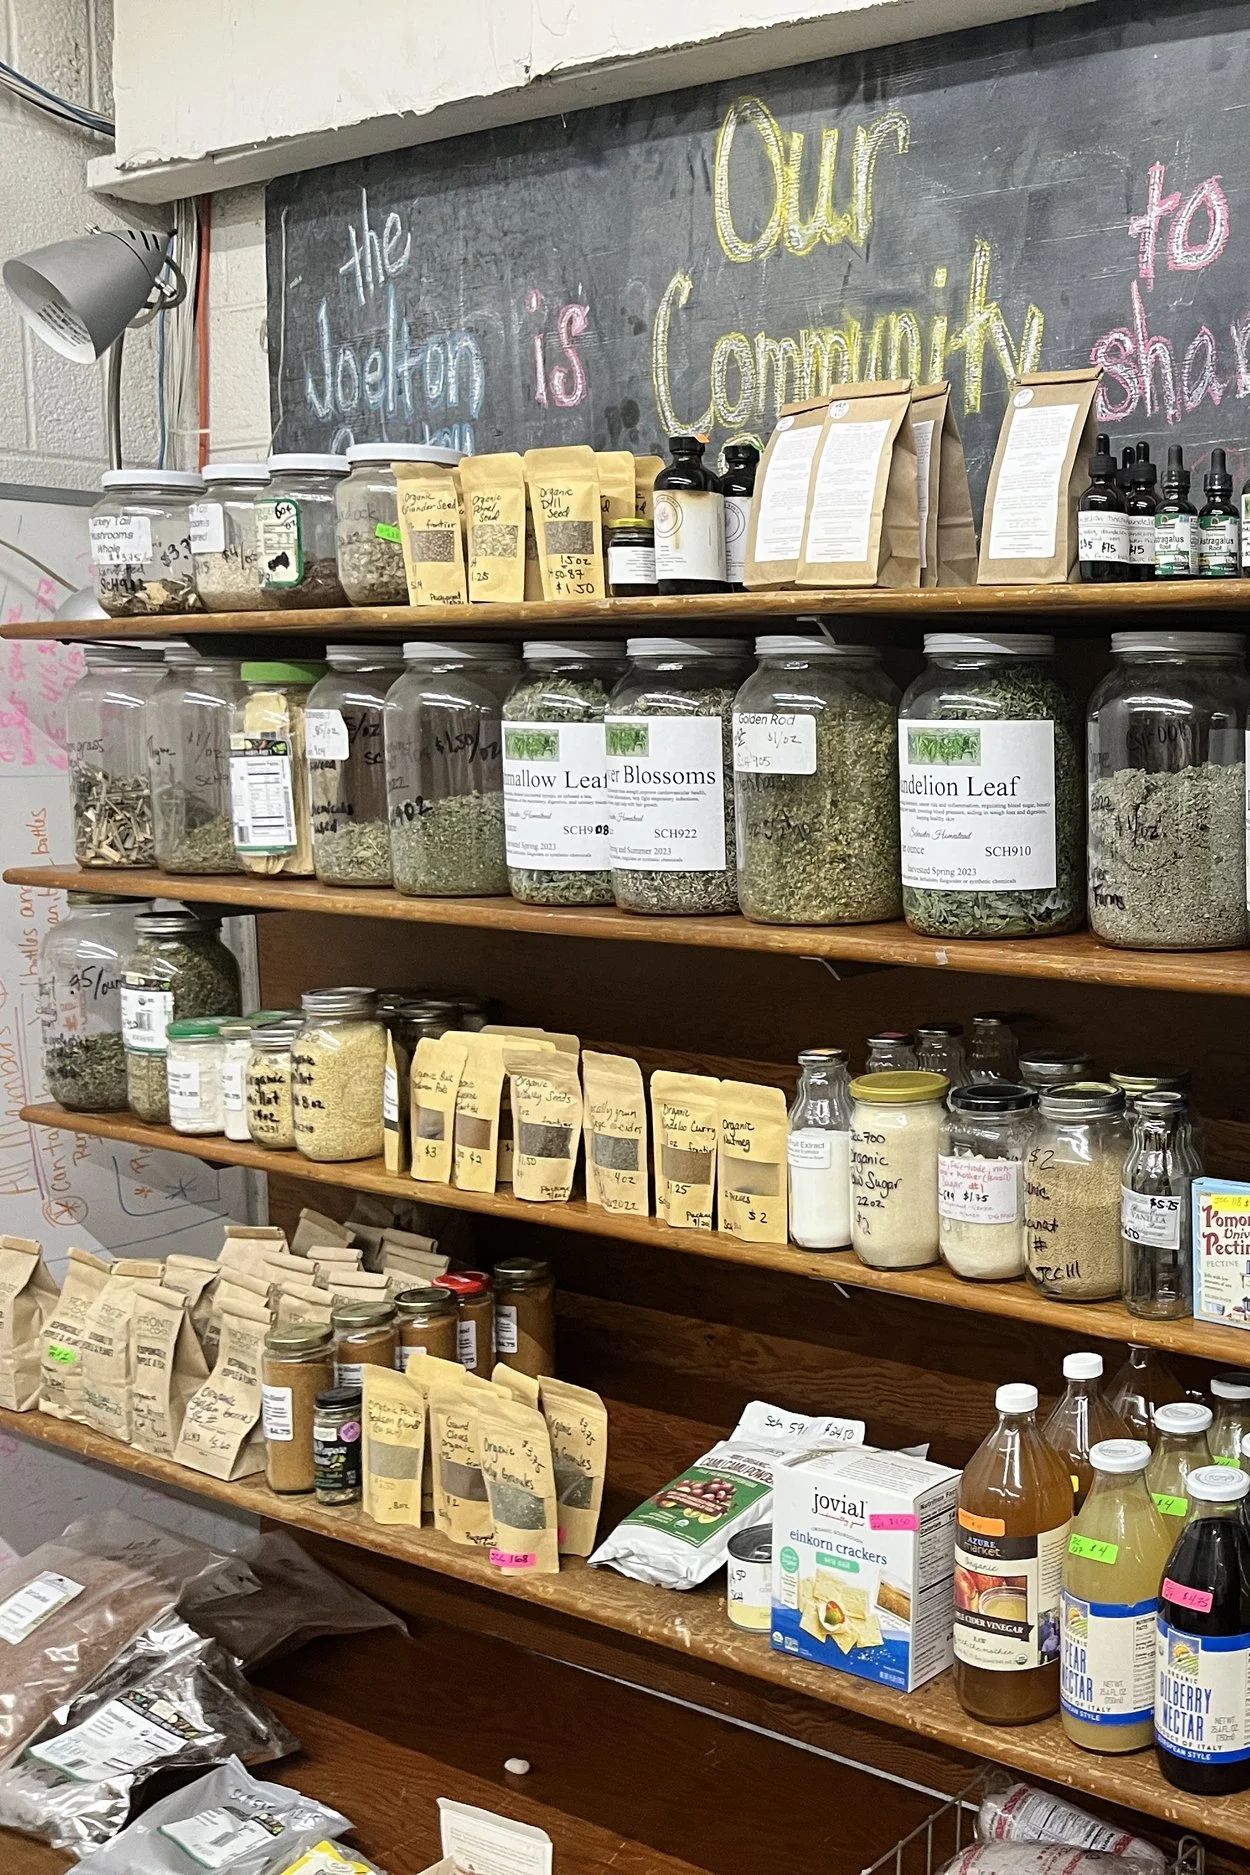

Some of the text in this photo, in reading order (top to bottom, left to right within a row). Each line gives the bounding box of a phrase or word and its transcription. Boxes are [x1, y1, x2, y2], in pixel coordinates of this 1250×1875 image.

[715, 97, 910, 262] Our
[1130, 161, 1229, 291] to
[339, 187, 411, 306] the
[305, 284, 486, 420] Joelton
[534, 287, 591, 408] is
[738, 712, 796, 726] Golden Rod
[624, 764, 716, 786] Blossoms
[967, 775, 1021, 797] Leaf
[654, 828, 698, 839] SCH922
[654, 847, 672, 856] 2023
[984, 845, 1032, 857] SCH910
[931, 864, 977, 878] Spring 2023
[800, 1140, 825, 1150] Extract
[1028, 1148, 1056, 1172] $2
[865, 1171, 904, 1199] Sugar
[1131, 1212, 1168, 1226] VANILLA
[1033, 1238, 1048, 1254] #
[1206, 1259, 1240, 1269] PECTINE
[811, 1486, 867, 1520] jovial
[789, 1528, 888, 1567] einkorn crackers
[963, 1541, 1002, 1558] market
[966, 1536, 998, 1549] AZURE
[964, 1615, 1025, 1635] CIDER VINEGAR
[1160, 1670, 1213, 1715] BILBERRY
[1079, 1710, 1101, 1723] STYLE
[1087, 1703, 1112, 1714] ITALY
[1161, 1701, 1205, 1742] NECTAR
[1182, 1740, 1223, 1752] OF ITALY
[1187, 1750, 1212, 1761] STYLE
